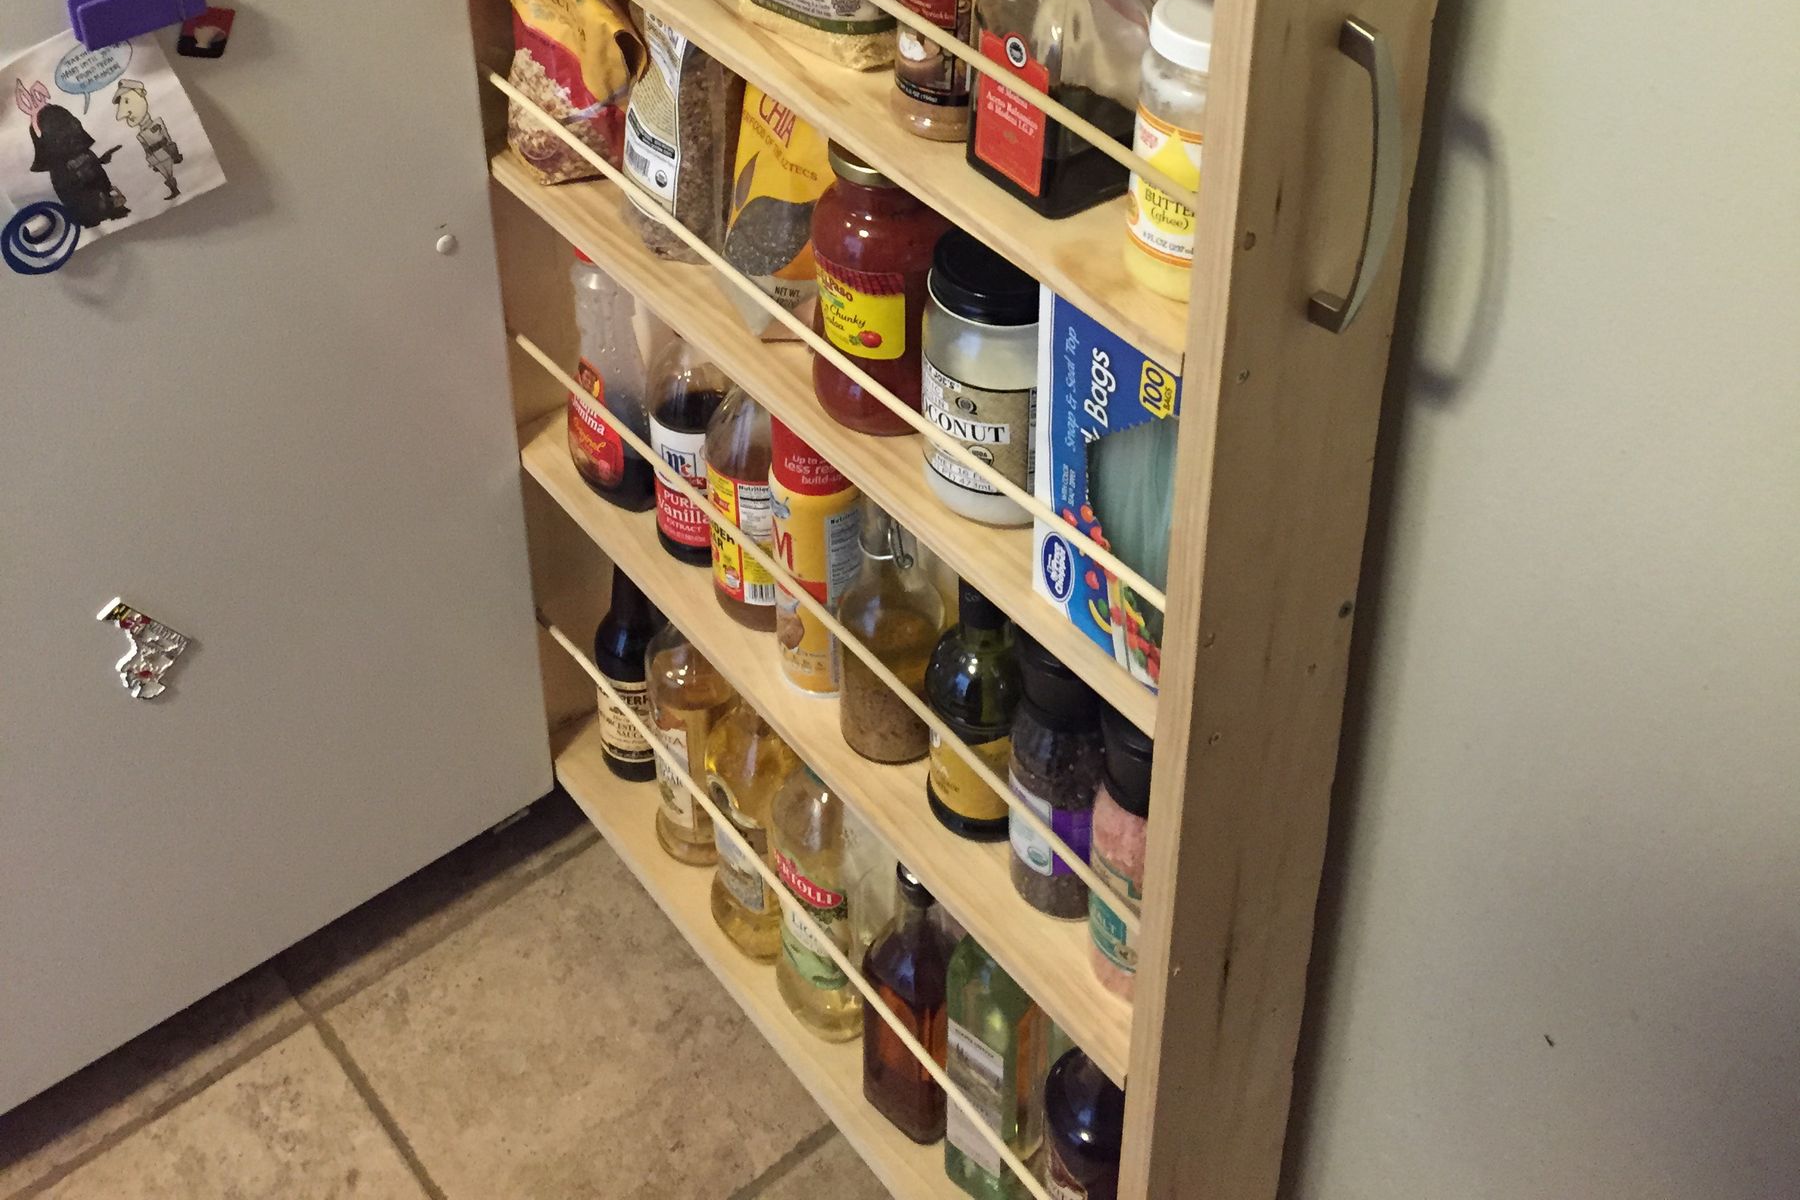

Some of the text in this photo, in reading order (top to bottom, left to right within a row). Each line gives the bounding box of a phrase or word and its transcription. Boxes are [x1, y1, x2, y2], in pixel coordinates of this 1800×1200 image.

[759, 93, 796, 149] CHIA
[830, 304, 867, 329] Chunky
[1065, 326, 1080, 357] Top
[1083, 347, 1116, 429] Bags
[1142, 366, 1165, 411] 100
[1064, 415, 1080, 453] Snap
[784, 457, 811, 475] less
[658, 493, 710, 524] Vanilla
